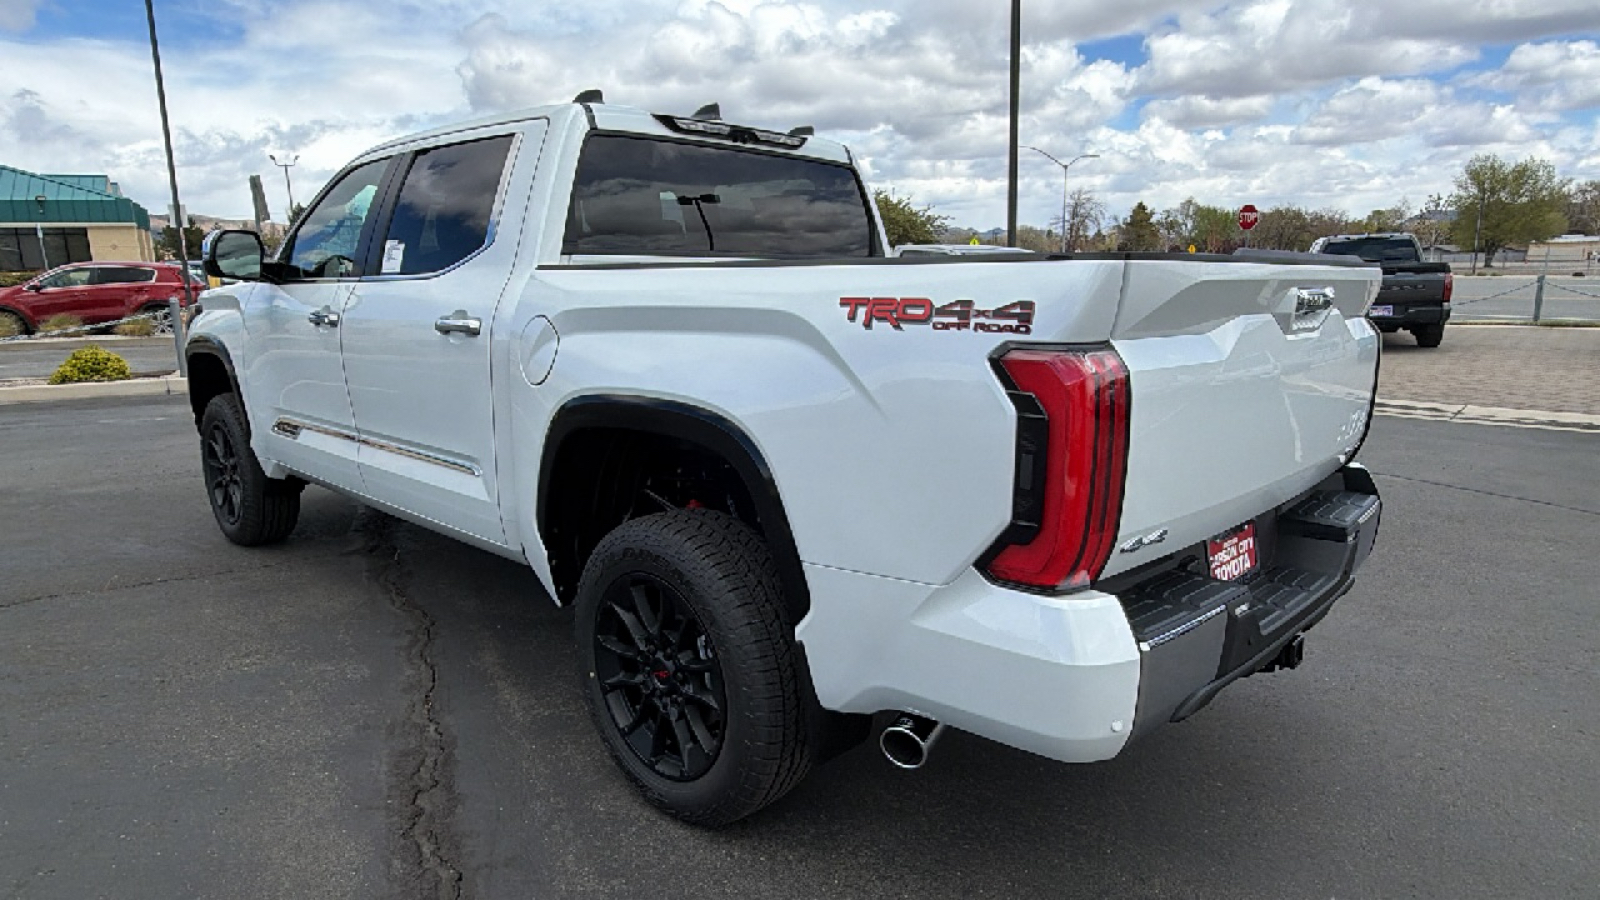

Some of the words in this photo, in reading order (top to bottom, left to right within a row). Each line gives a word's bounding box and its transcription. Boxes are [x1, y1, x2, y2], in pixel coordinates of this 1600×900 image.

[1240, 212, 1257, 222] STOP
[840, 297, 933, 331] TRD
[933, 322, 969, 331] OFF
[973, 323, 1033, 335] ROAD
[1239, 537, 1254, 553] CITY
[1215, 552, 1251, 580] TOYOTA
